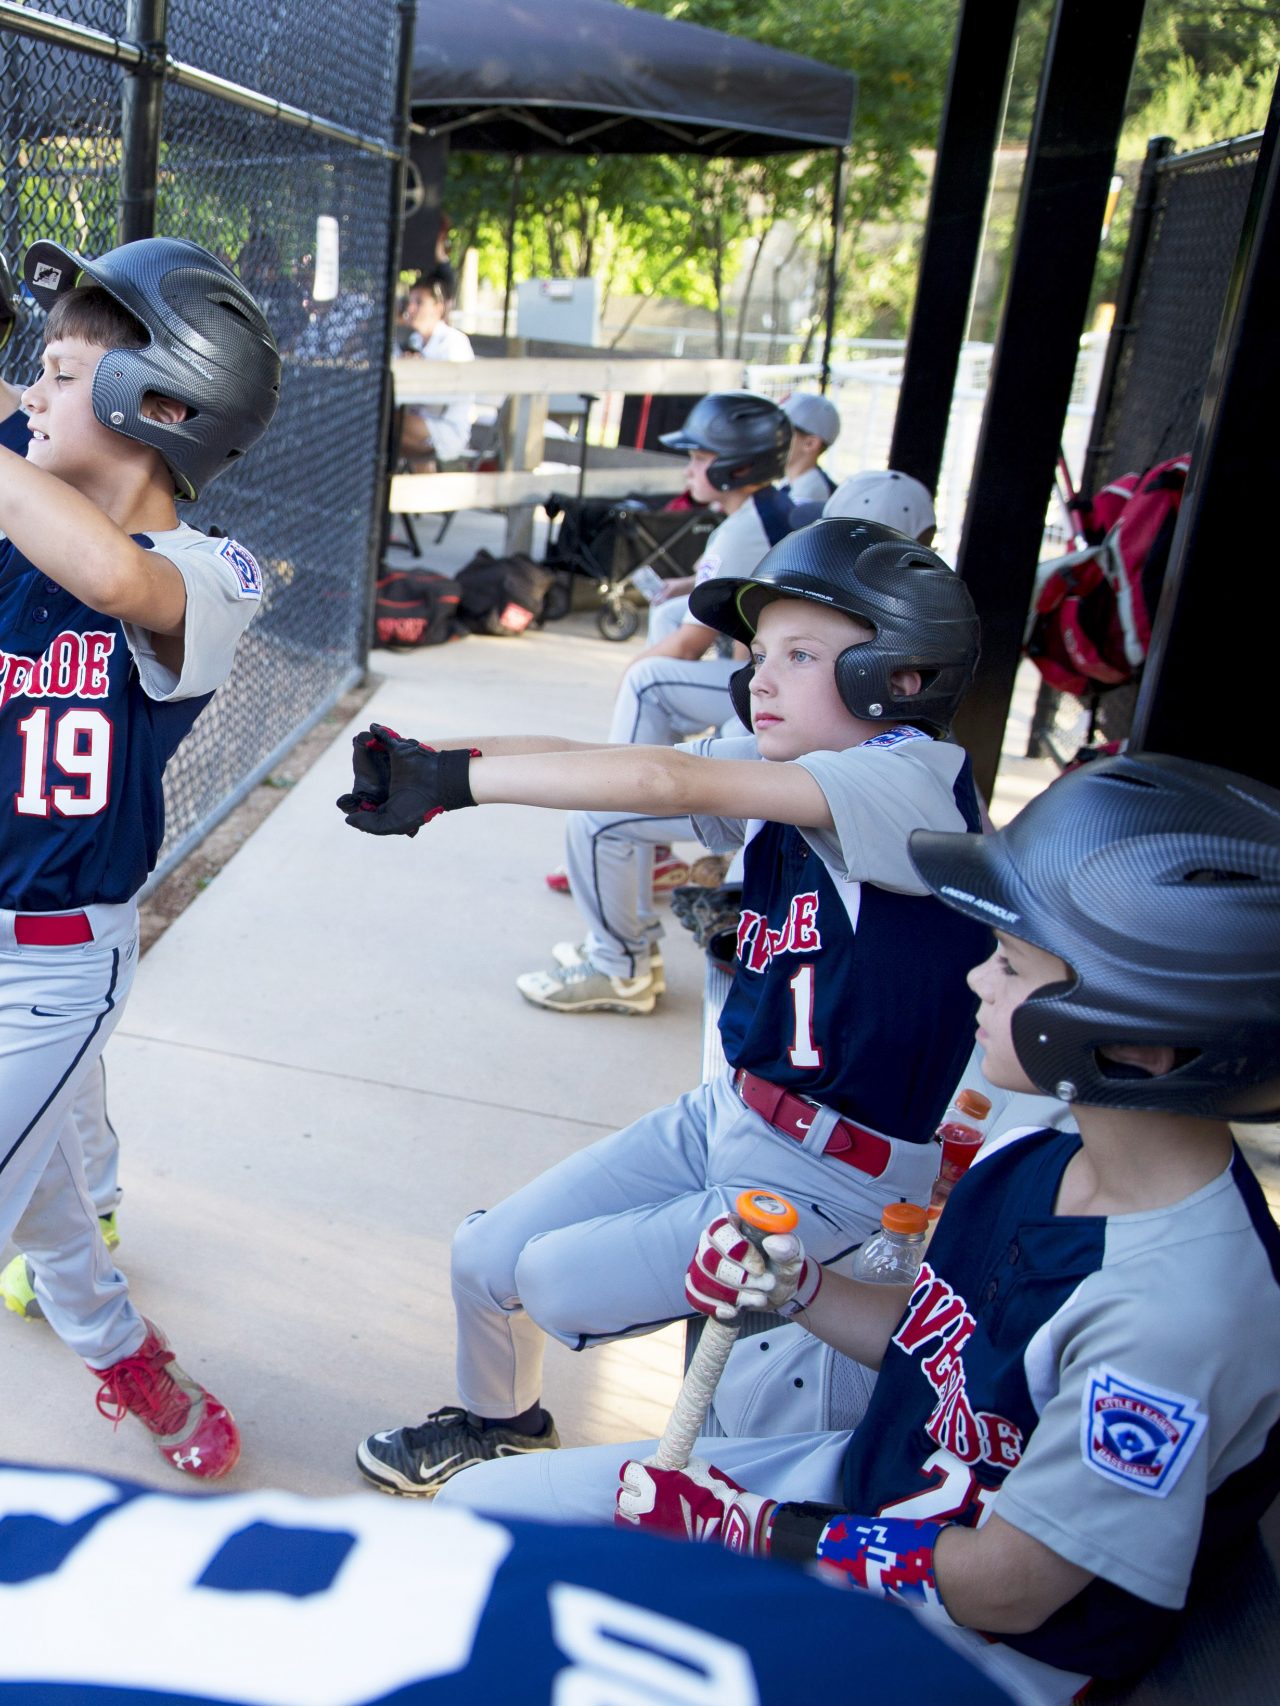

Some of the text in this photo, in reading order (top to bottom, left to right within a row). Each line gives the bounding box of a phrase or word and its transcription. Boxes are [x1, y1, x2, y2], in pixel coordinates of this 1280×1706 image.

[13, 705, 114, 820] 19
[940, 885, 1021, 924] UNDER ARMOUR
[786, 962, 825, 1070] 1
[1098, 1396, 1176, 1440] LITTLE LEAGUE
[1096, 1448, 1156, 1477] BASEBALL
